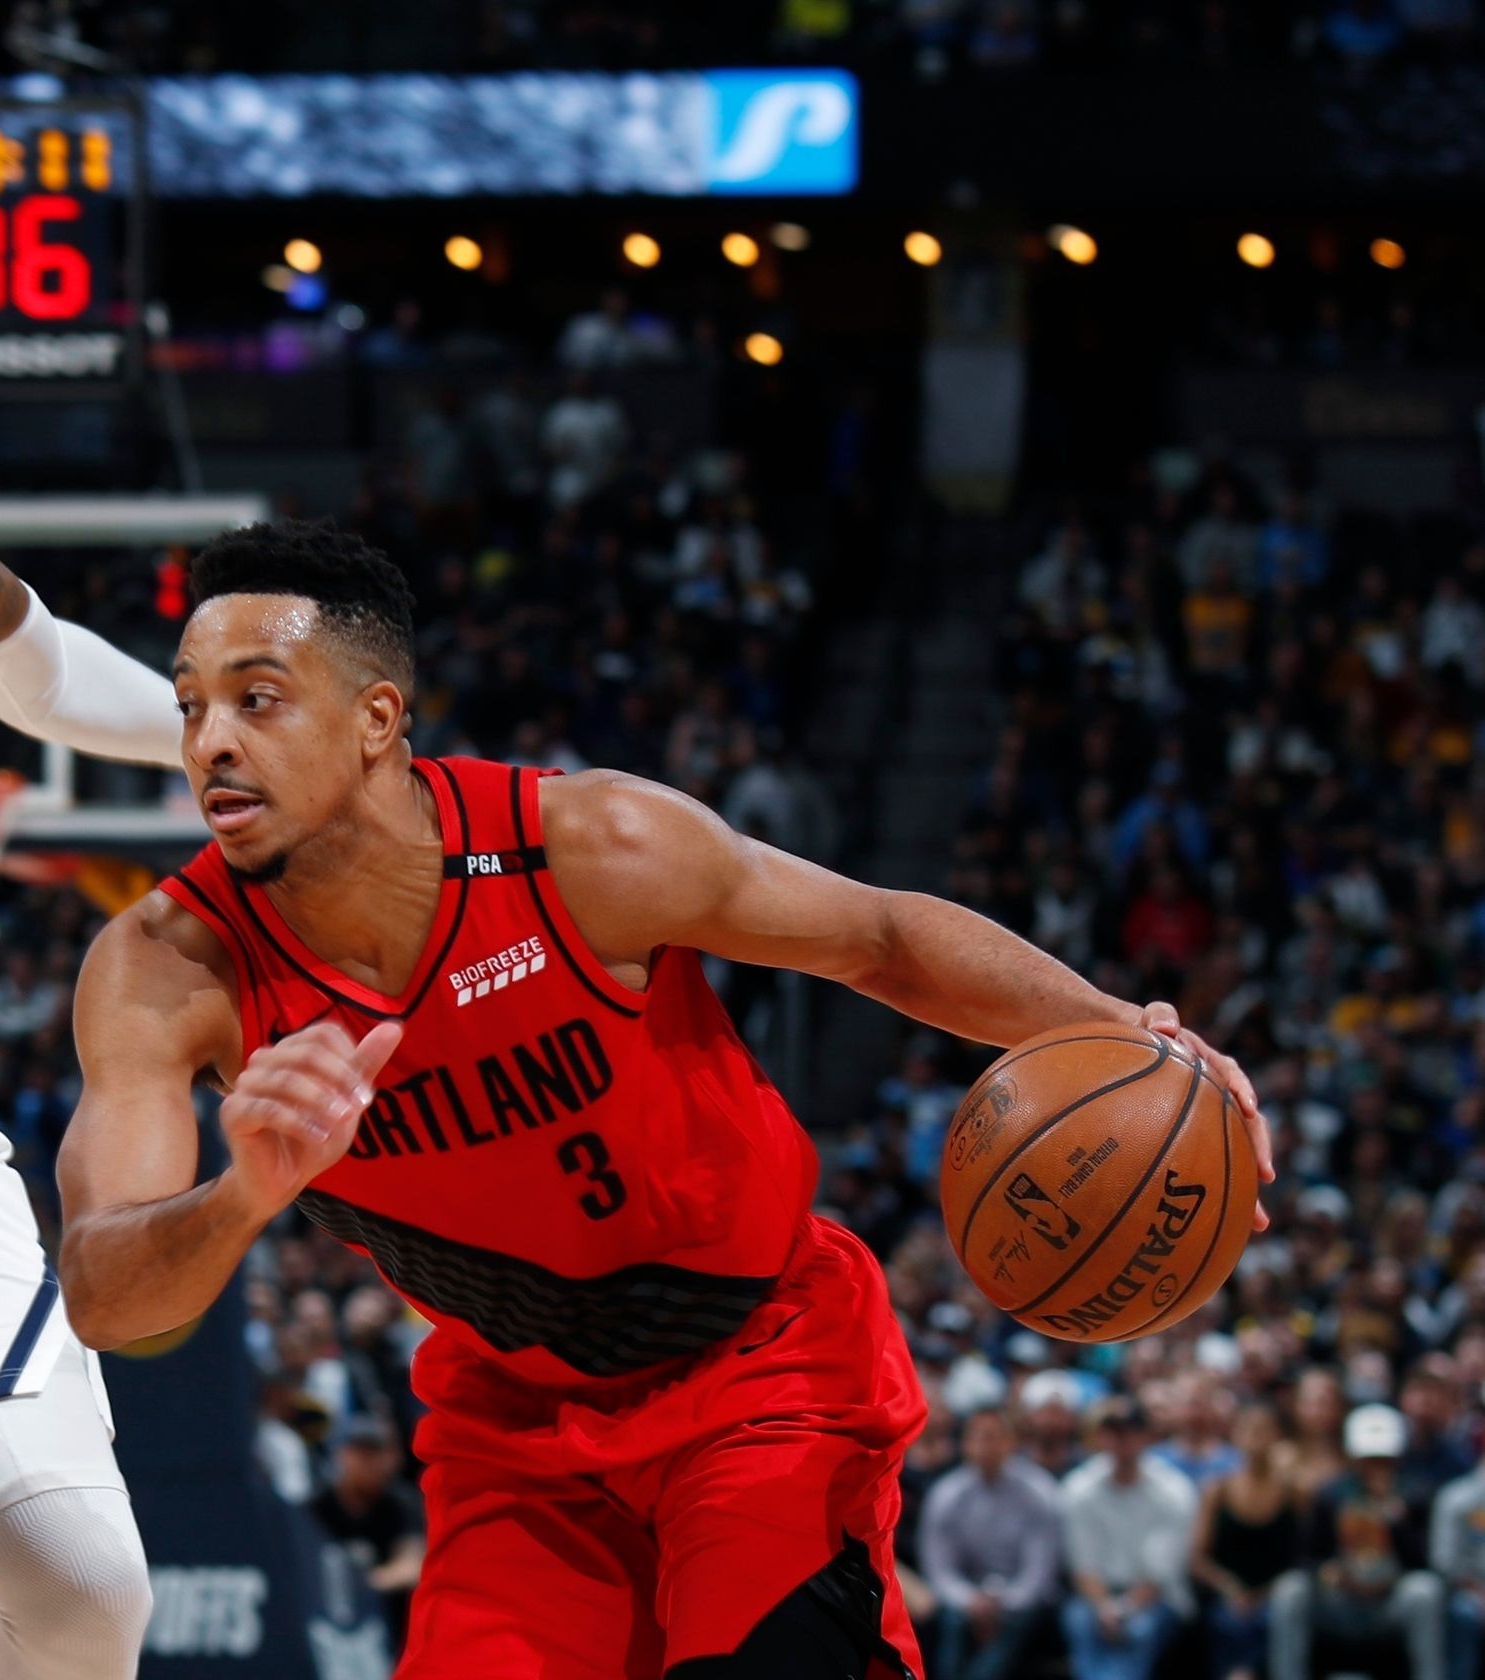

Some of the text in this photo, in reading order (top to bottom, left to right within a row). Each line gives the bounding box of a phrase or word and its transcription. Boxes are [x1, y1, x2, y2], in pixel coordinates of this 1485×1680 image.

[466, 854, 502, 876] PGA
[347, 1017, 614, 1160] ORTLAND
[555, 1130, 628, 1222] 3
[1057, 1136, 1120, 1200] OFFICIAL GAME BALL
[1038, 1169, 1206, 1337] SPALDING
